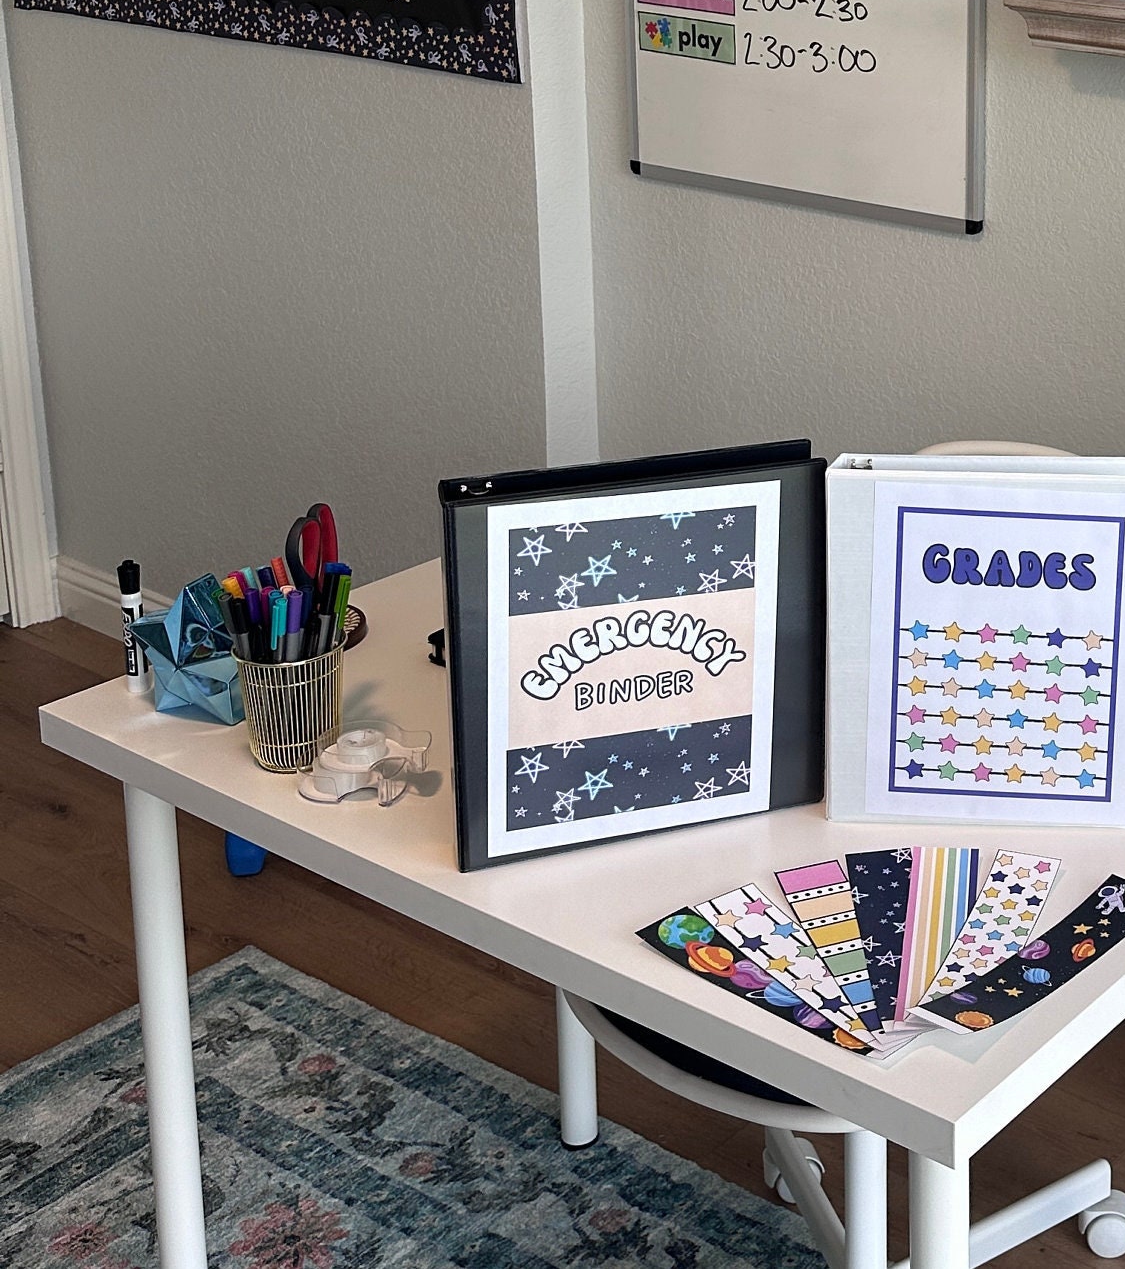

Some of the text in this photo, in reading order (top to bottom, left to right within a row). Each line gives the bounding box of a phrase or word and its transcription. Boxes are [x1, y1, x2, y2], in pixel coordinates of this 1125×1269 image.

[678, 24, 723, 57] play
[921, 543, 1097, 590] GRADES
[519, 609, 747, 701] EMERGENCY
[574, 669, 693, 711] BINDER
